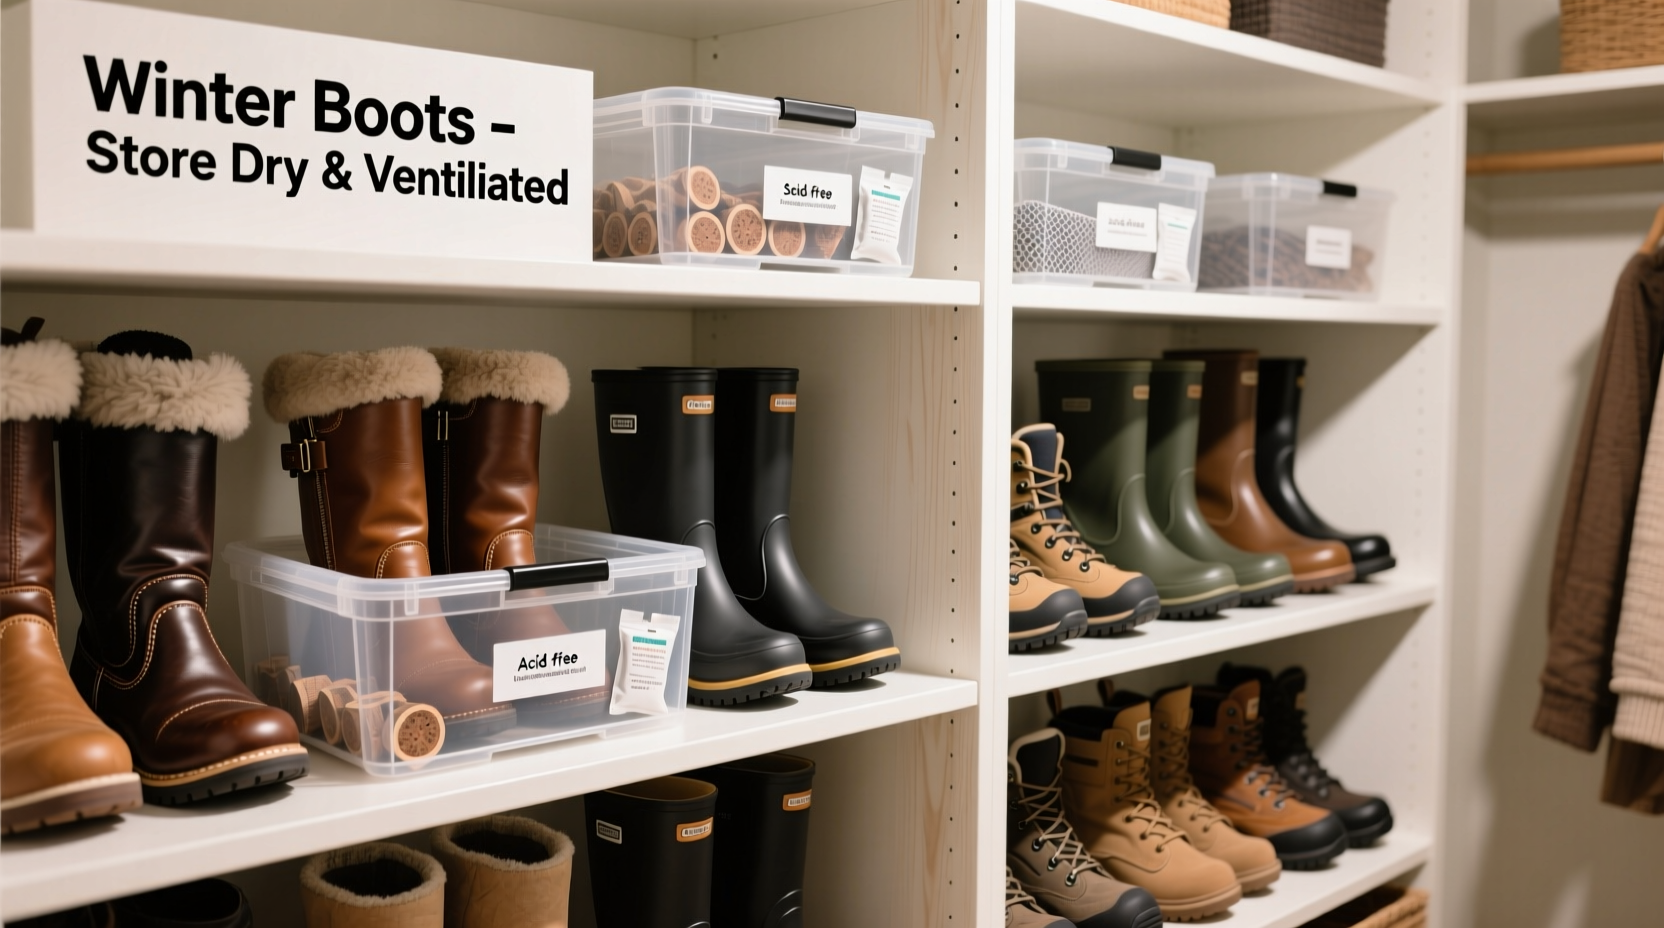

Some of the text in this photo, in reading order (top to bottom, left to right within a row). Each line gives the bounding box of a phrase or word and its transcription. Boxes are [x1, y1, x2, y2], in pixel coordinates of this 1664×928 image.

[83, 54, 296, 129] Winter
[314, 79, 476, 146] Boots
[86, 130, 569, 206] Store Dry & Ventiliated
[517, 652, 547, 672] Acid
